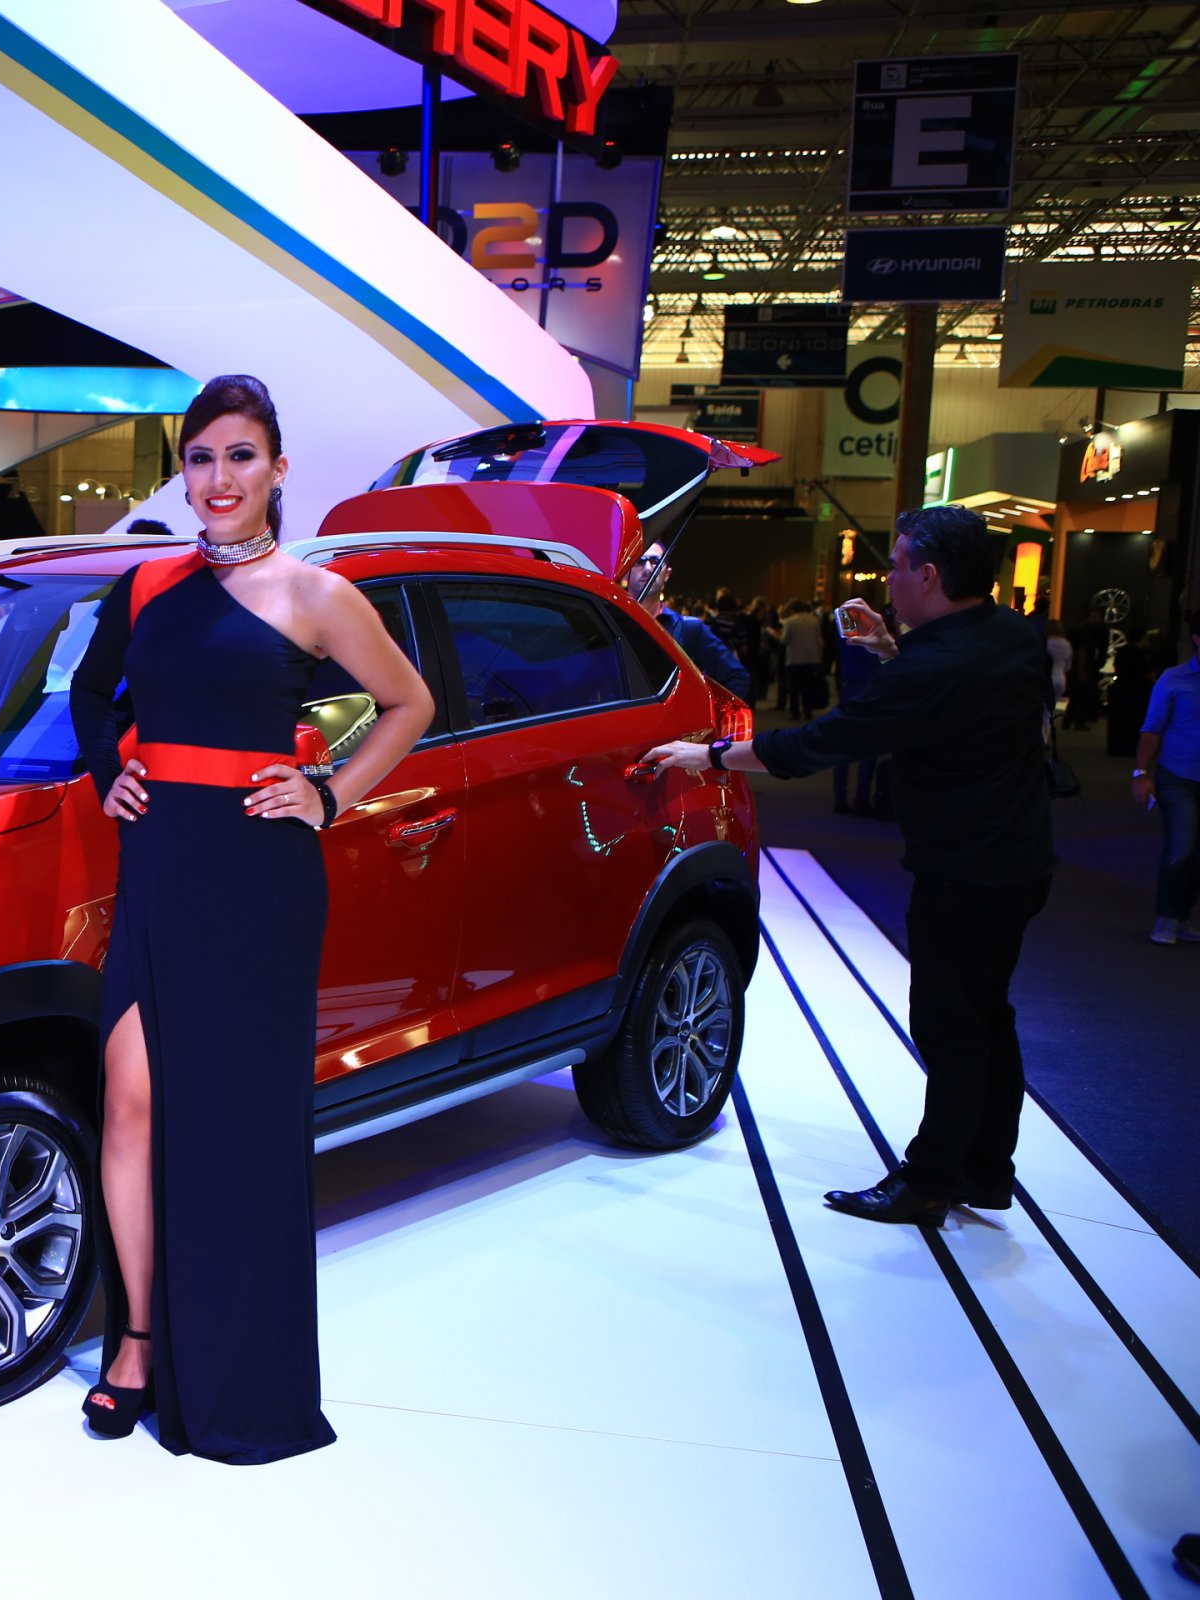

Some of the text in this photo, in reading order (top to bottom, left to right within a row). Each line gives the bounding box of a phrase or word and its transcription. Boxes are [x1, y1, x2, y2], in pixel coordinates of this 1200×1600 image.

[891, 95, 973, 188] E
[900, 257, 981, 272] HYUNDAI
[490, 277, 603, 292] ORS
[1065, 297, 1164, 309] PETROBRAS
